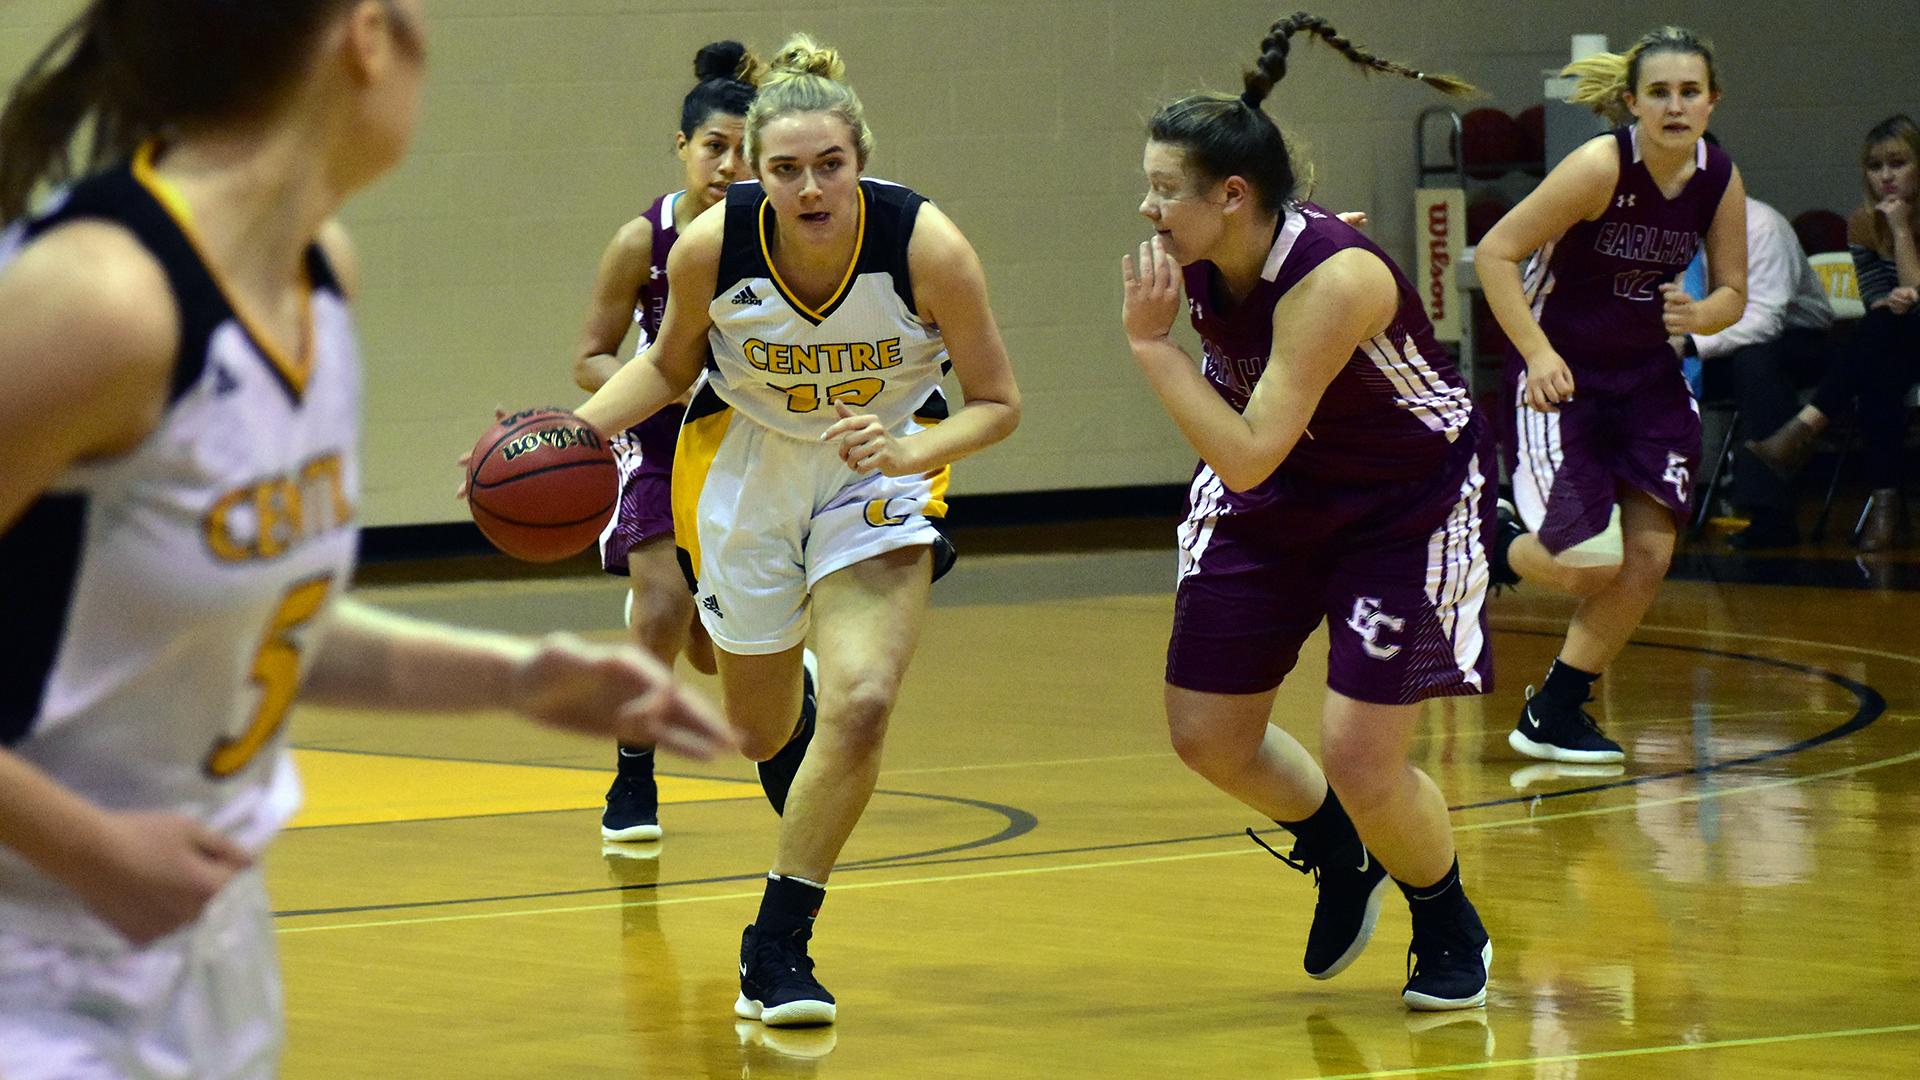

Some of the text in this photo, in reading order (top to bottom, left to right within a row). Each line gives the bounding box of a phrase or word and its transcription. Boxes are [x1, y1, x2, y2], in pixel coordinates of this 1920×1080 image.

[1429, 201, 1450, 321] Wilson
[743, 337, 903, 374] CENTRE
[502, 425, 602, 461] Wilson
[1346, 595, 1405, 661] EC
